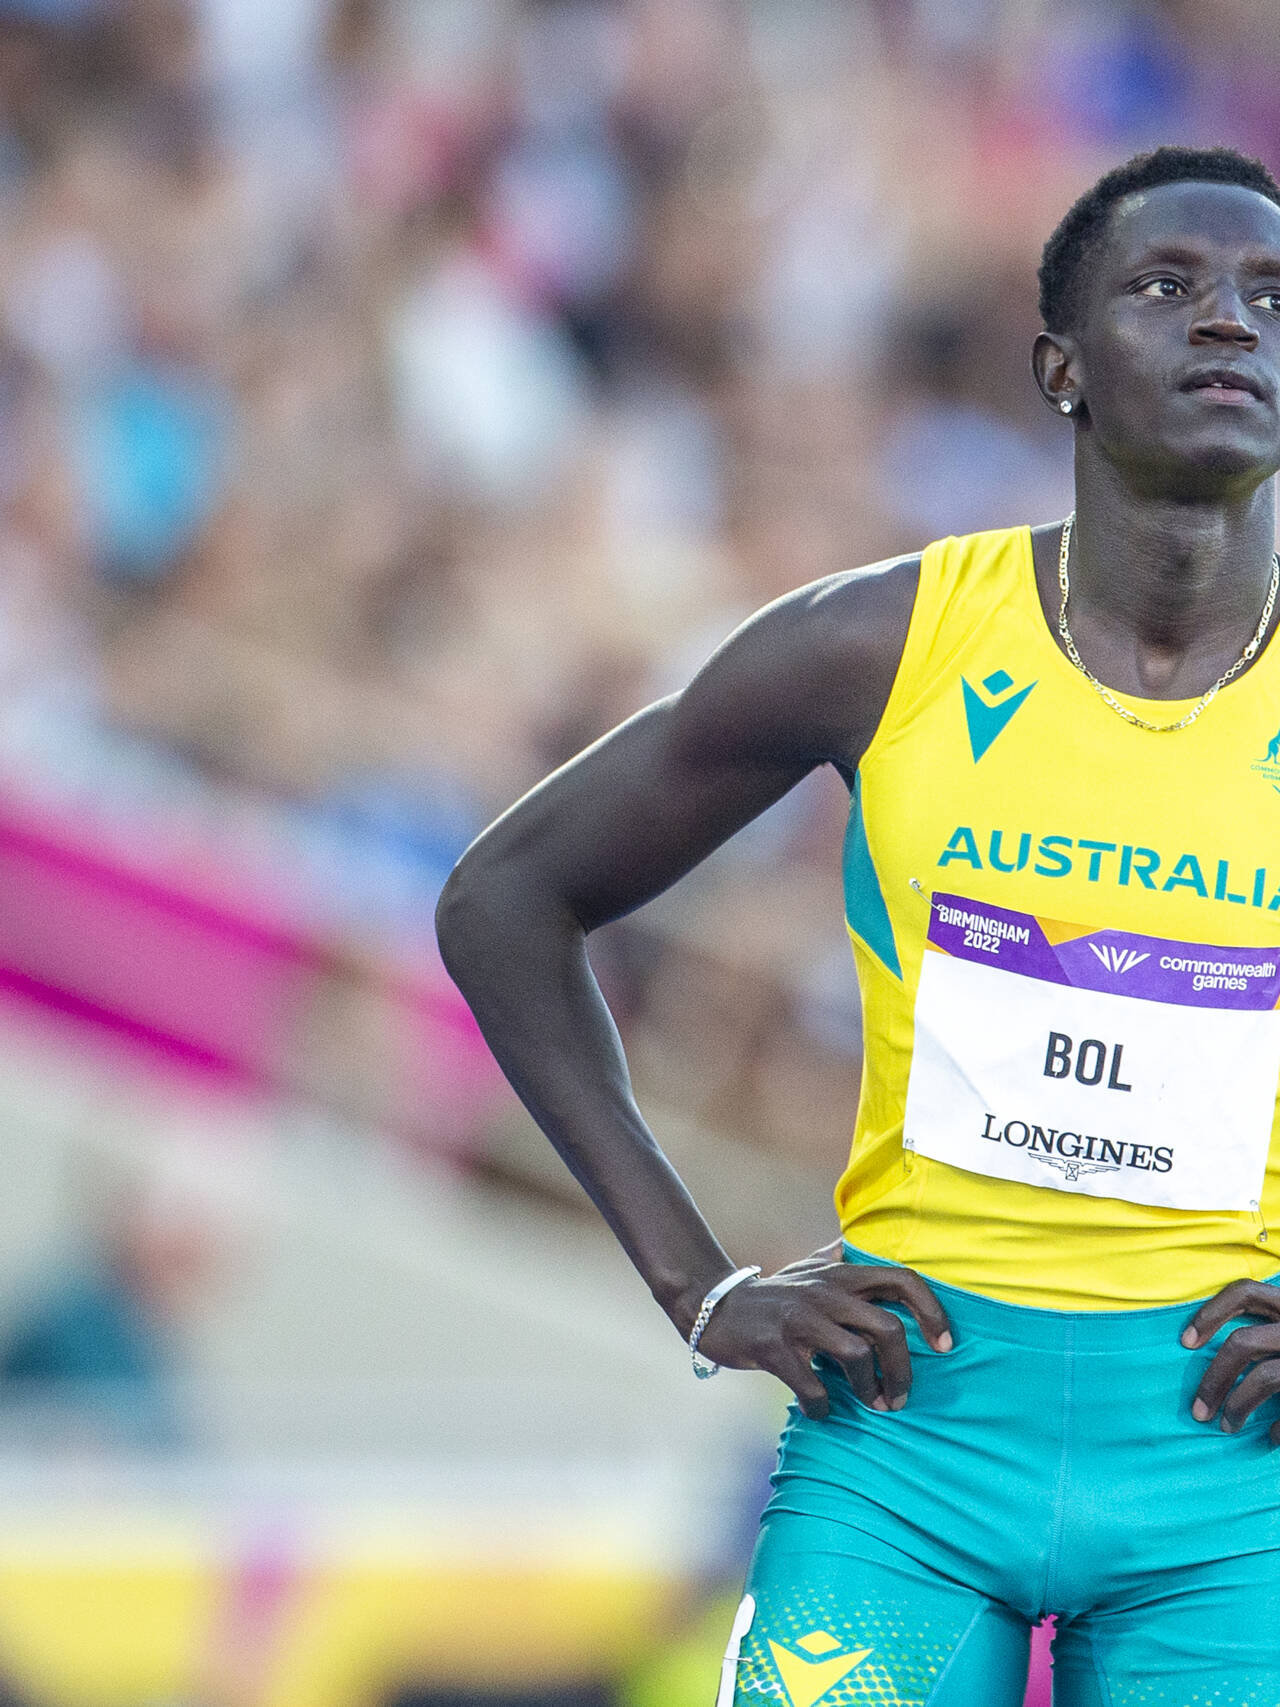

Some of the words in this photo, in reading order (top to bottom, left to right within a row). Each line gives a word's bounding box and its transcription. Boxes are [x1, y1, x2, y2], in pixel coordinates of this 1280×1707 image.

[938, 907, 1031, 946] BIRMINGHAM
[963, 930, 1001, 954] 2022
[1159, 955, 1277, 978] commonwealth
[1192, 974, 1247, 991] games
[1043, 1031, 1132, 1092] BOL
[981, 1113, 1174, 1173] LONGINES
